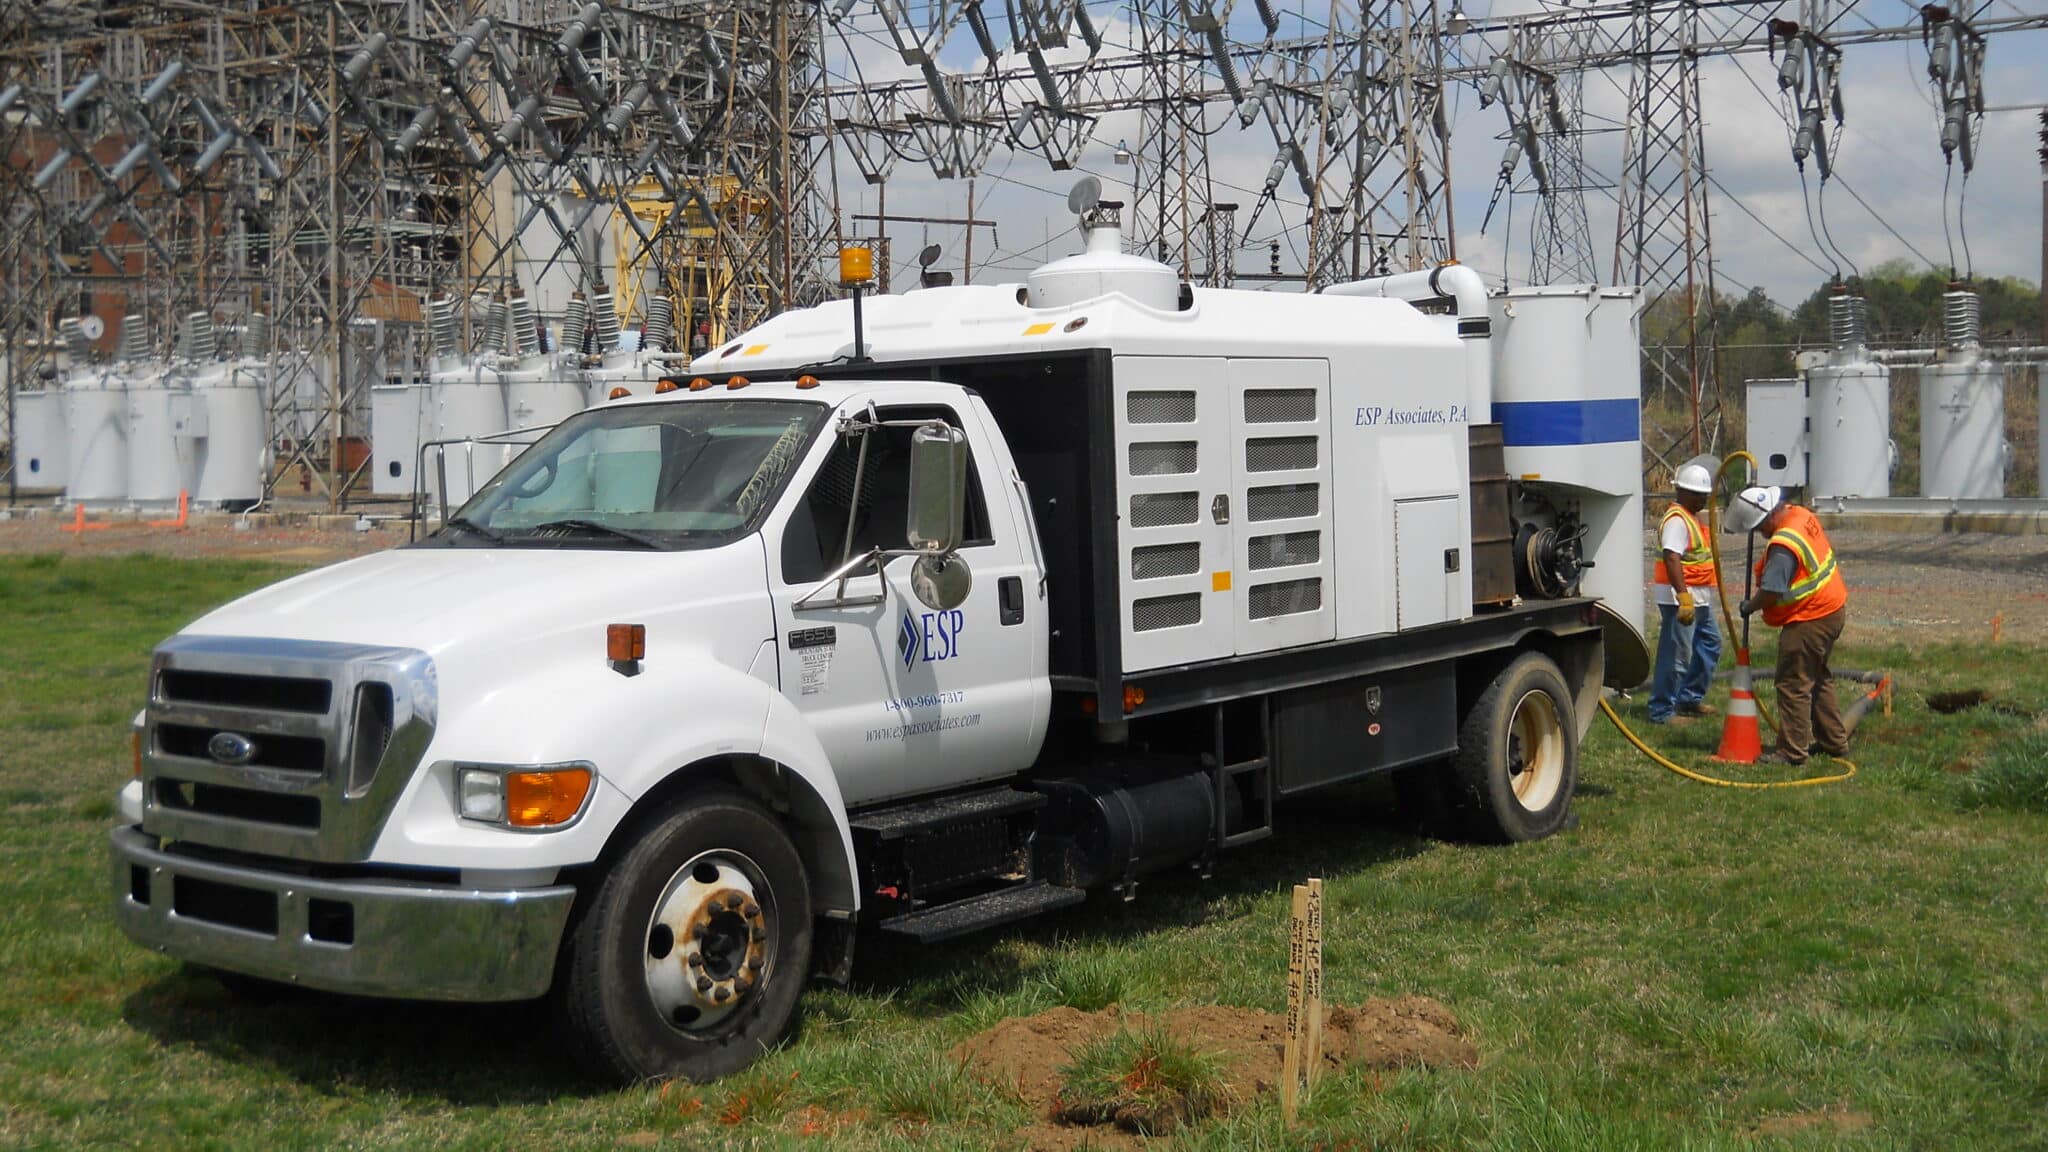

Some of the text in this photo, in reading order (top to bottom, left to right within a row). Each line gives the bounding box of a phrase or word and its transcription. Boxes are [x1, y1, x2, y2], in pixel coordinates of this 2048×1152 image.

[1355, 407, 1382, 426] ESP
[1385, 405, 1446, 425] Associates,
[921, 609, 965, 662] ESP
[884, 691, 964, 712] 1-800-960-7317
[865, 712, 981, 742] www.espassociates.com
